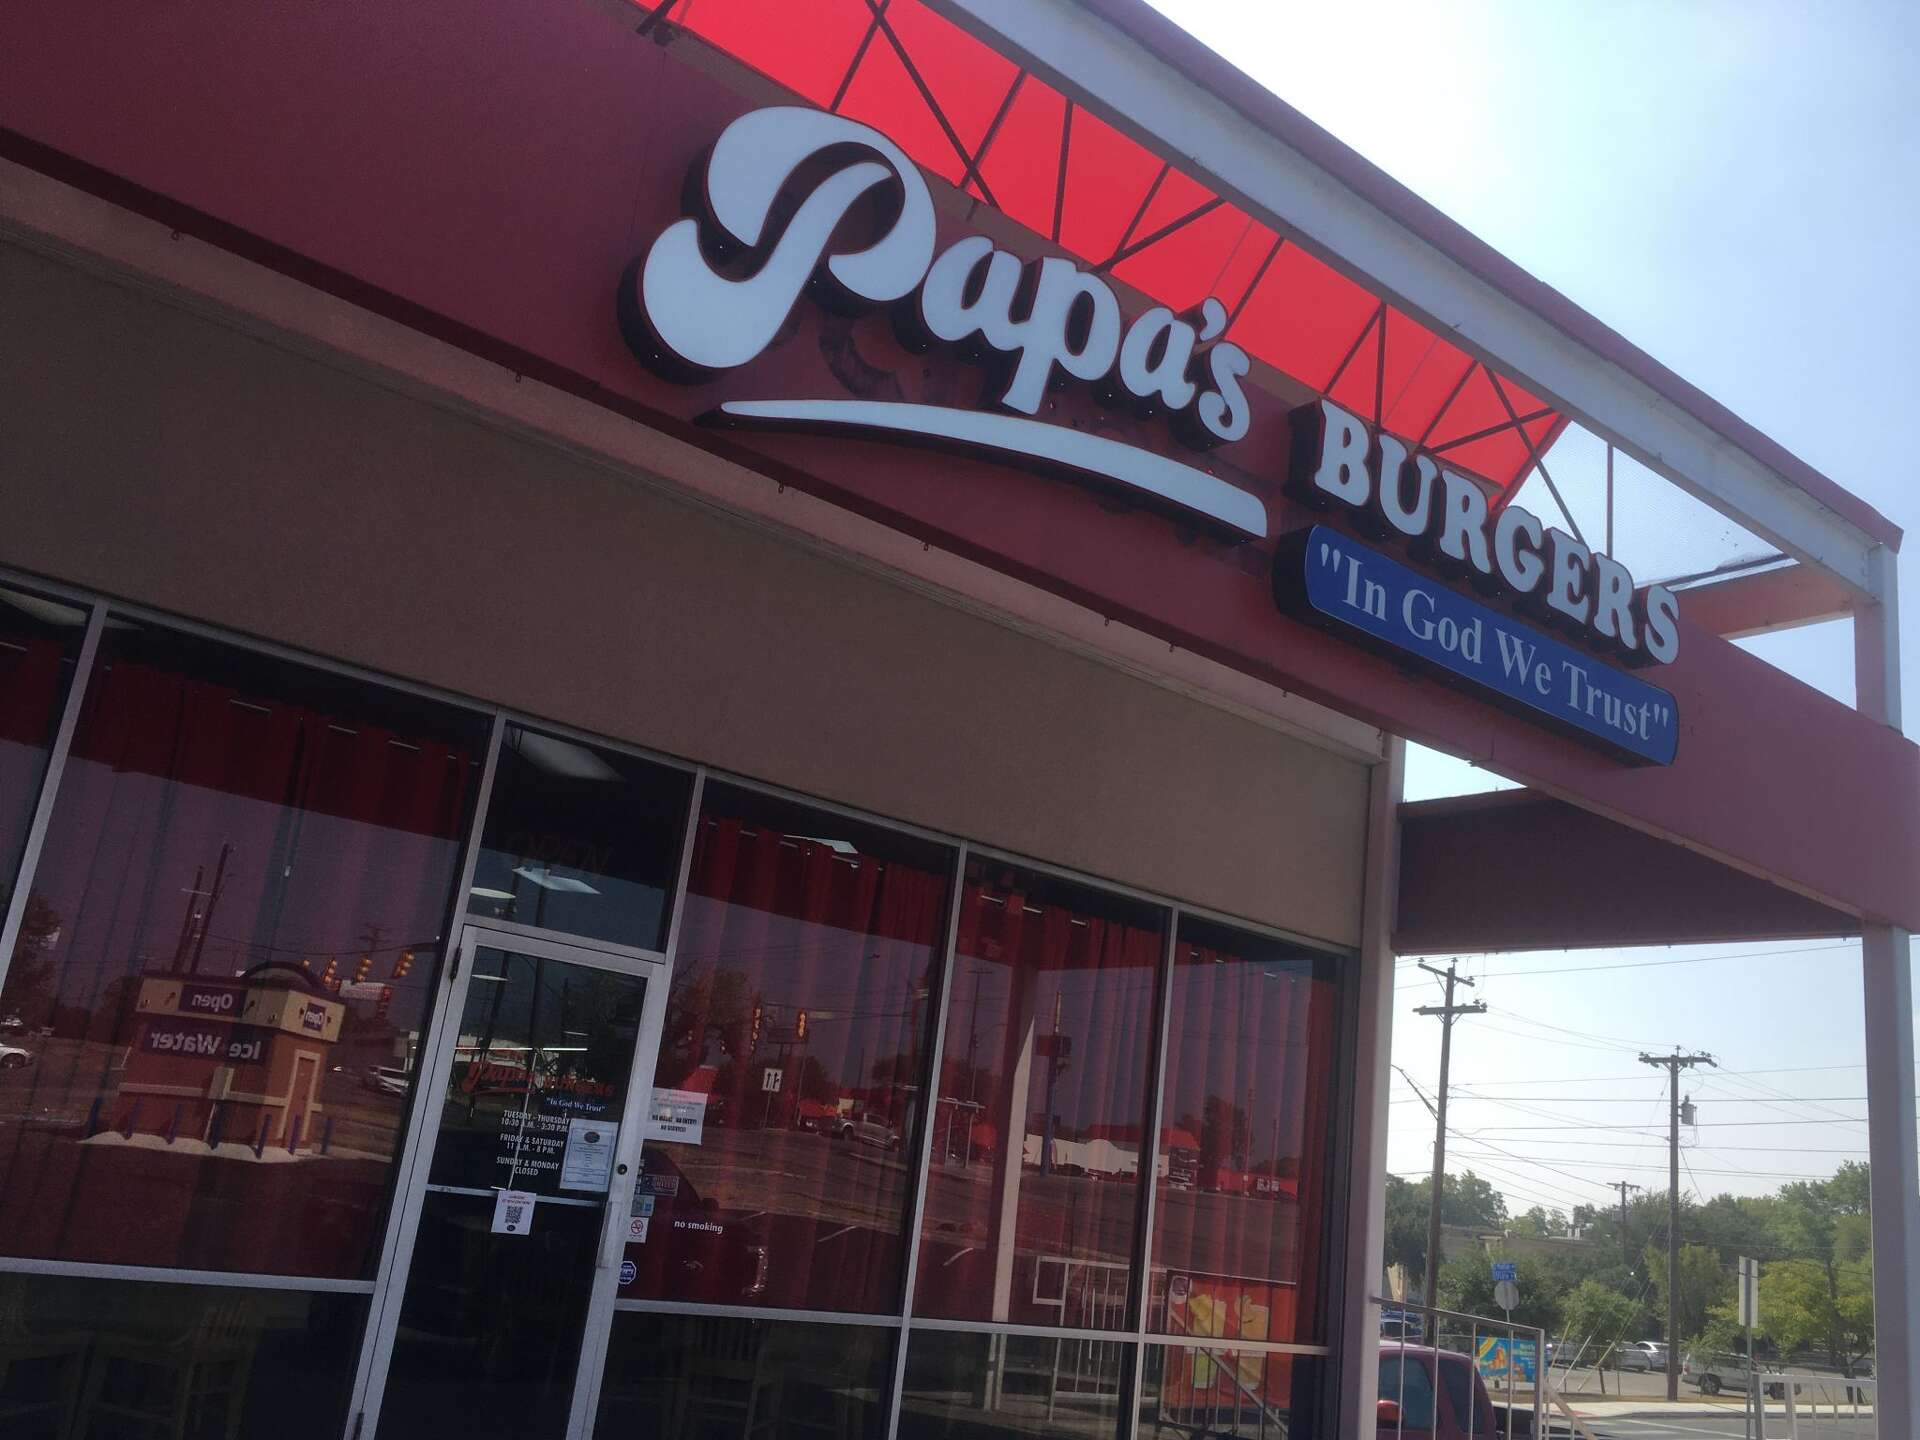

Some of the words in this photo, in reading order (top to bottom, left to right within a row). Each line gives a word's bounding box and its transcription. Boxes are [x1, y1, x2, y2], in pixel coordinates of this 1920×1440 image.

[643, 106, 1250, 442] Papa's
[1314, 399, 1680, 664] BURGERS
[1321, 543, 1387, 621] "In
[1402, 588, 1482, 664] God
[1495, 627, 1552, 696] We
[1562, 661, 1669, 740] Trust"
[501, 1117, 520, 1126] 10:30
[504, 1110, 532, 1120] TUESDAY
[538, 1114, 570, 1125] THURSDAY
[500, 1133, 524, 1143] FRIDAY
[532, 1137, 564, 1148] SATURDAY
[497, 1156, 522, 1166] SUNDAY
[530, 1160, 559, 1170] MONDAY
[515, 1166, 539, 1176] CLOSED
[674, 1220, 686, 1228] no
[687, 1221, 723, 1234] smoking
